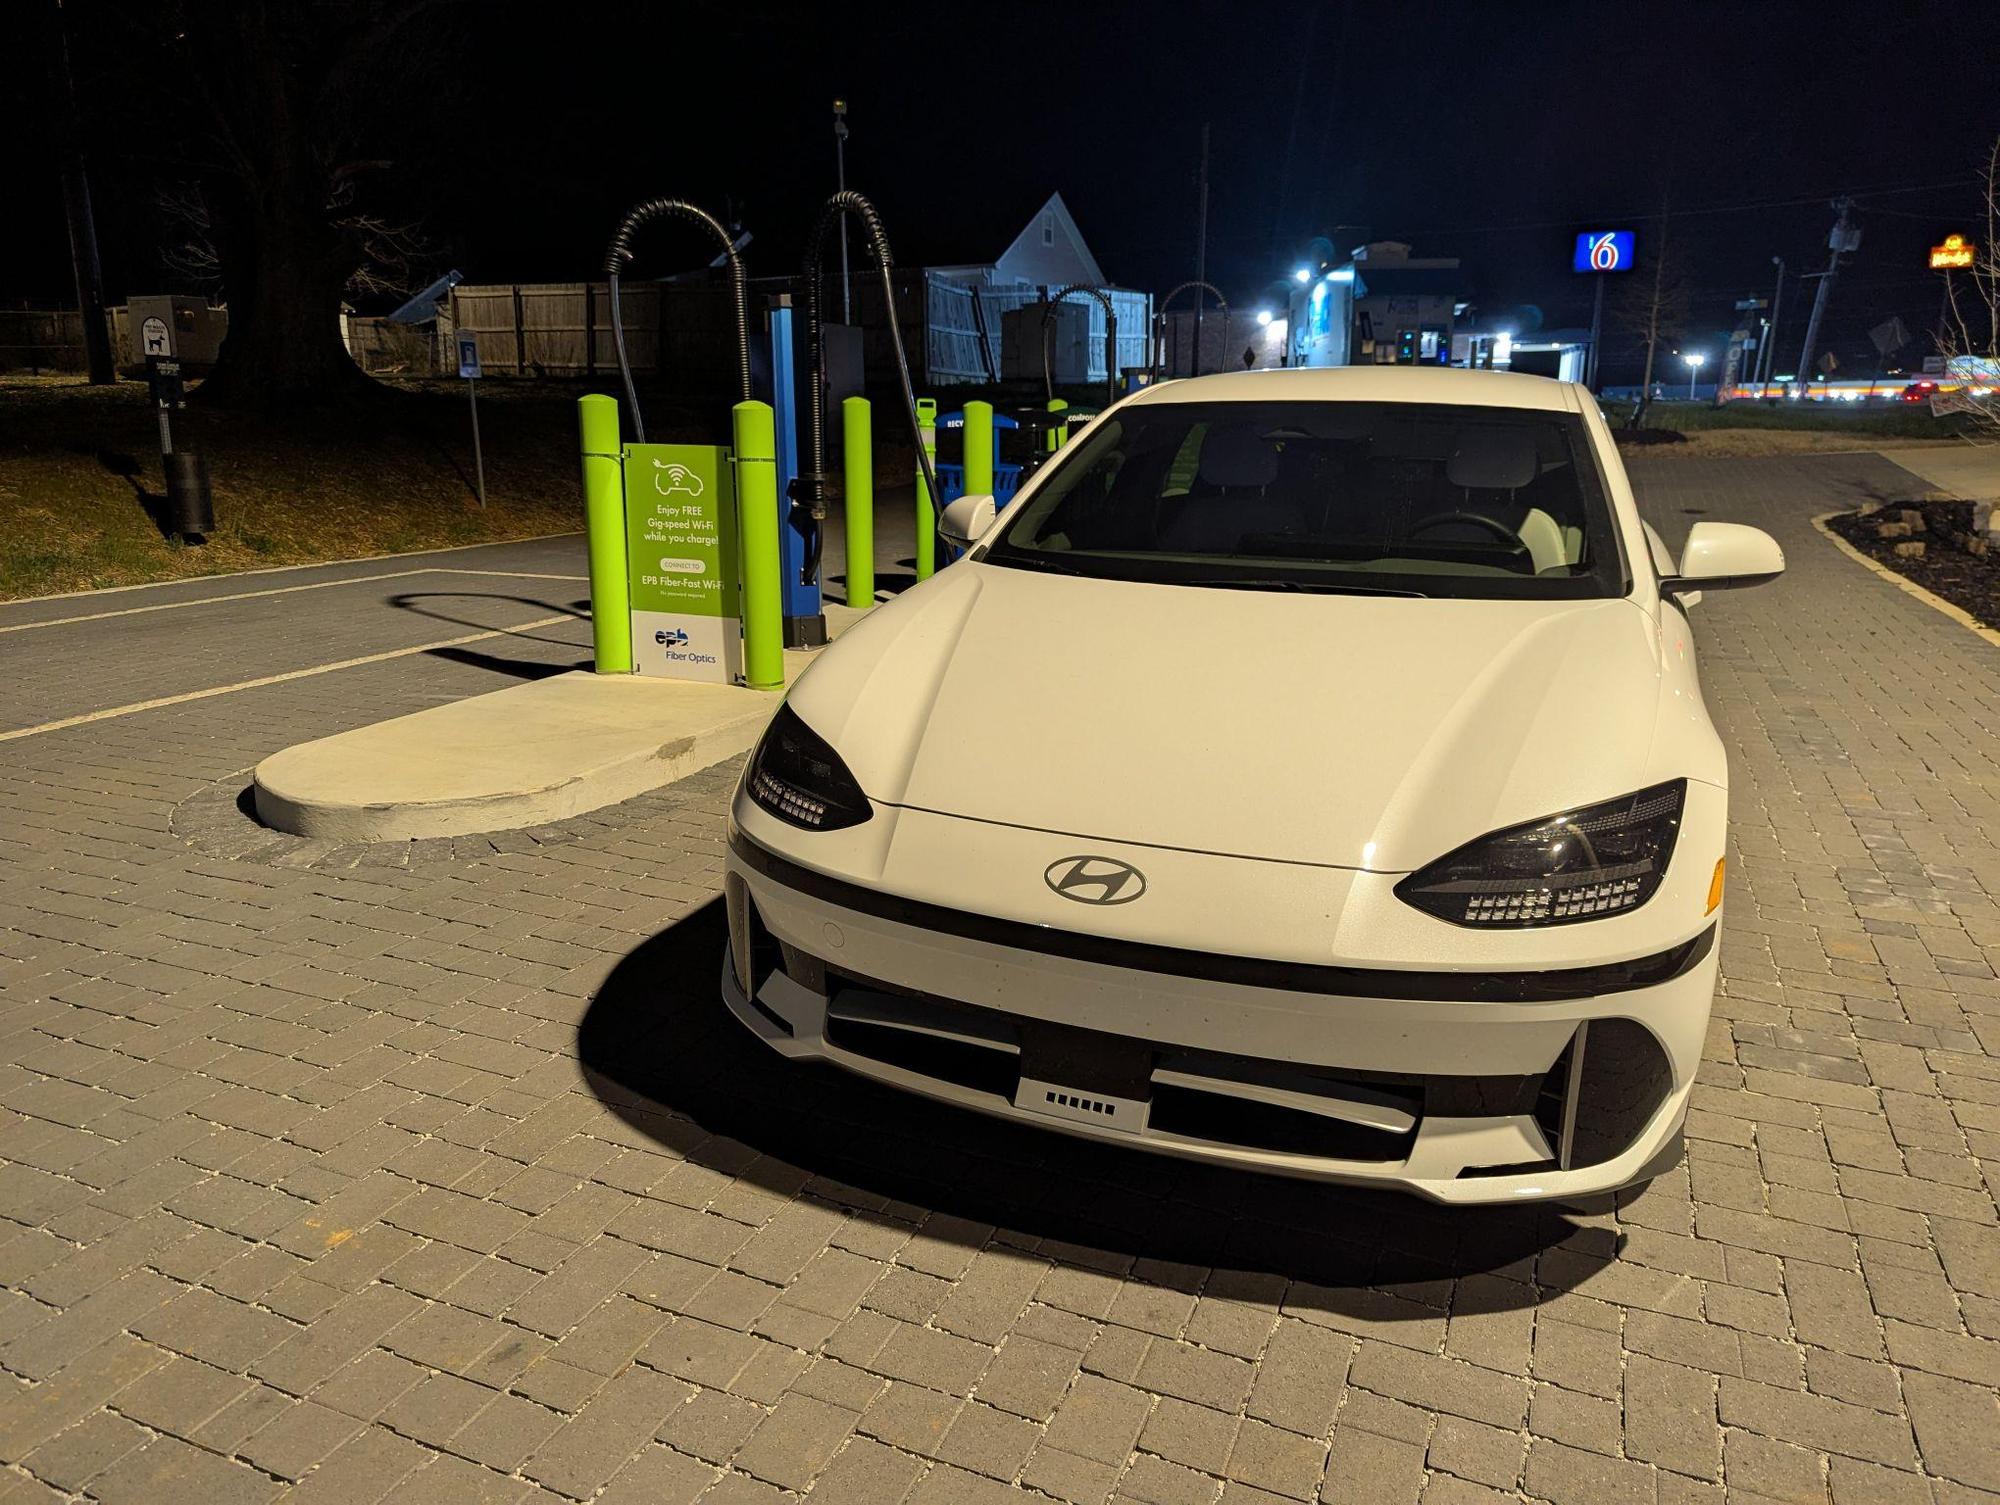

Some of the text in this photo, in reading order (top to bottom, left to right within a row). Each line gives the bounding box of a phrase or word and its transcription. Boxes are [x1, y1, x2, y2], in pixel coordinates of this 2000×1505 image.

[1590, 232, 1619, 270] 6
[657, 504, 702, 517] Enjoy FREE
[647, 518, 714, 530] Gig-speed Wi-Fi
[643, 531, 719, 546] while you charge!
[642, 575, 725, 590] EPB Fiber-Fast Wi-Fi
[666, 651, 717, 664] Fiber Optics
